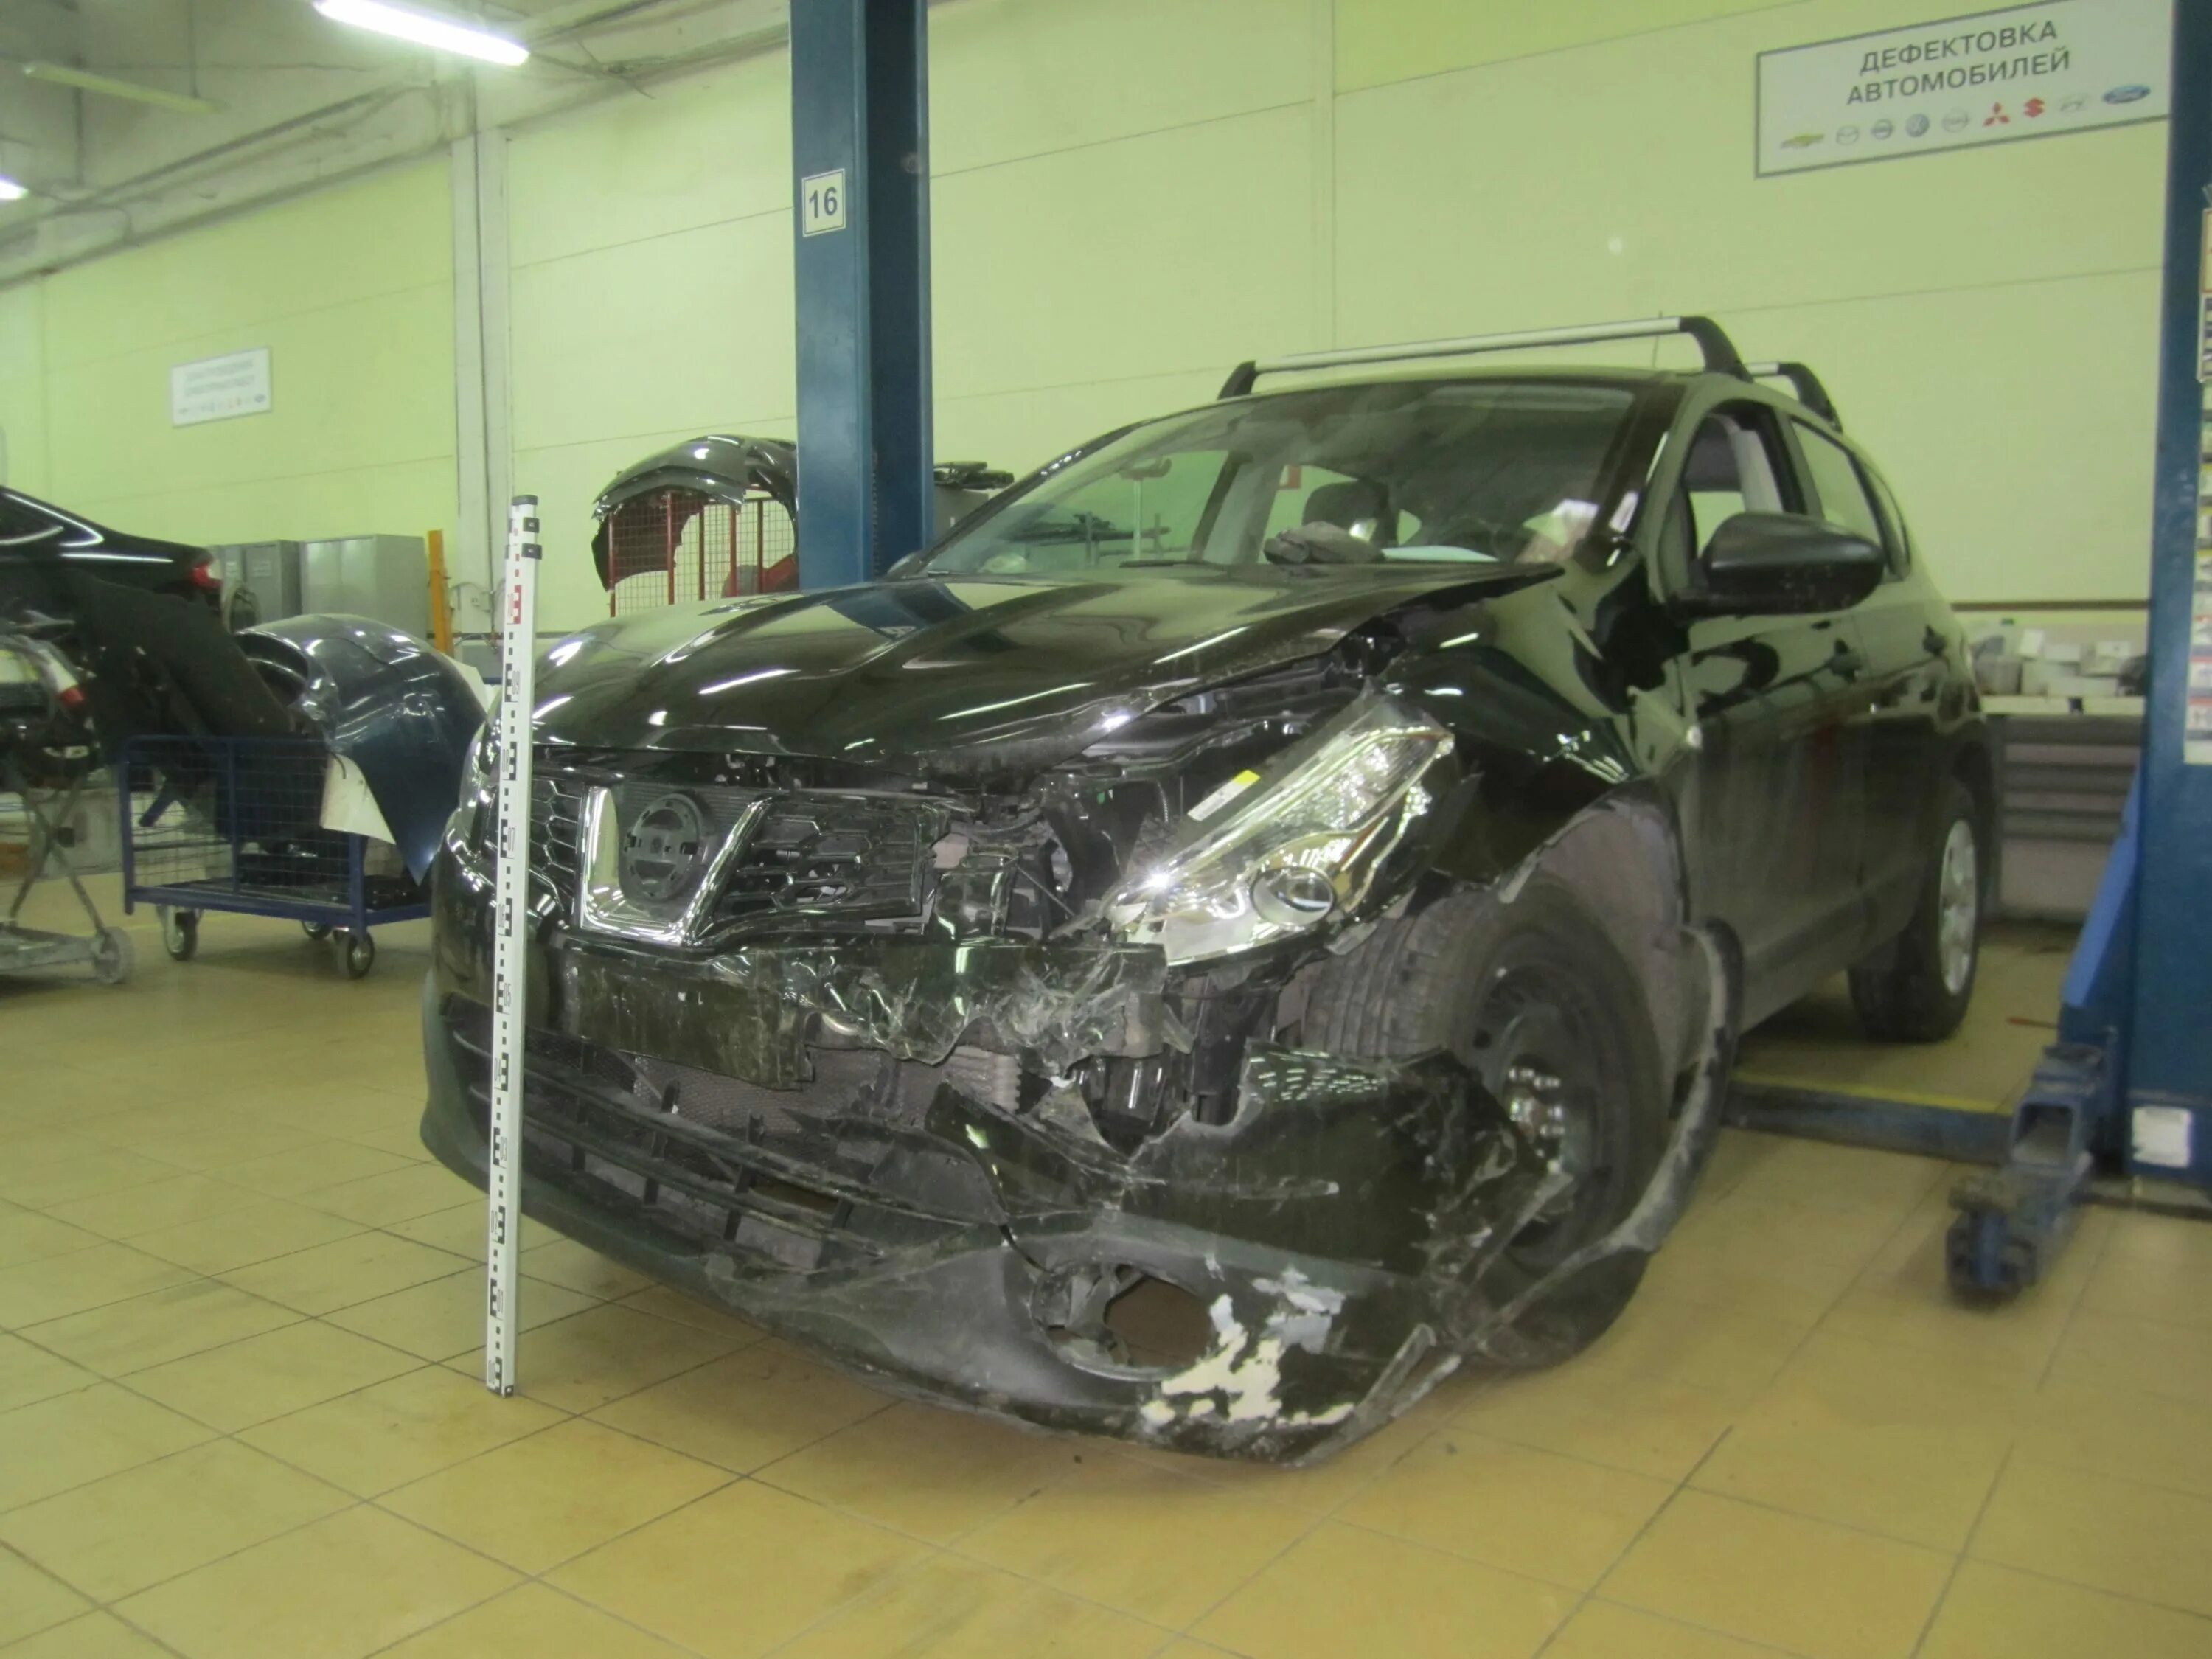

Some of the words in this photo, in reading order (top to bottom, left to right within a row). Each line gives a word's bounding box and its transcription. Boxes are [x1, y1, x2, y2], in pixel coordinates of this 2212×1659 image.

[1846, 45, 2070, 105] АВТОМОБИЛЕЙ
[1859, 20, 2058, 77] ДЕФЕКТОВКА
[809, 186, 838, 218] 16
